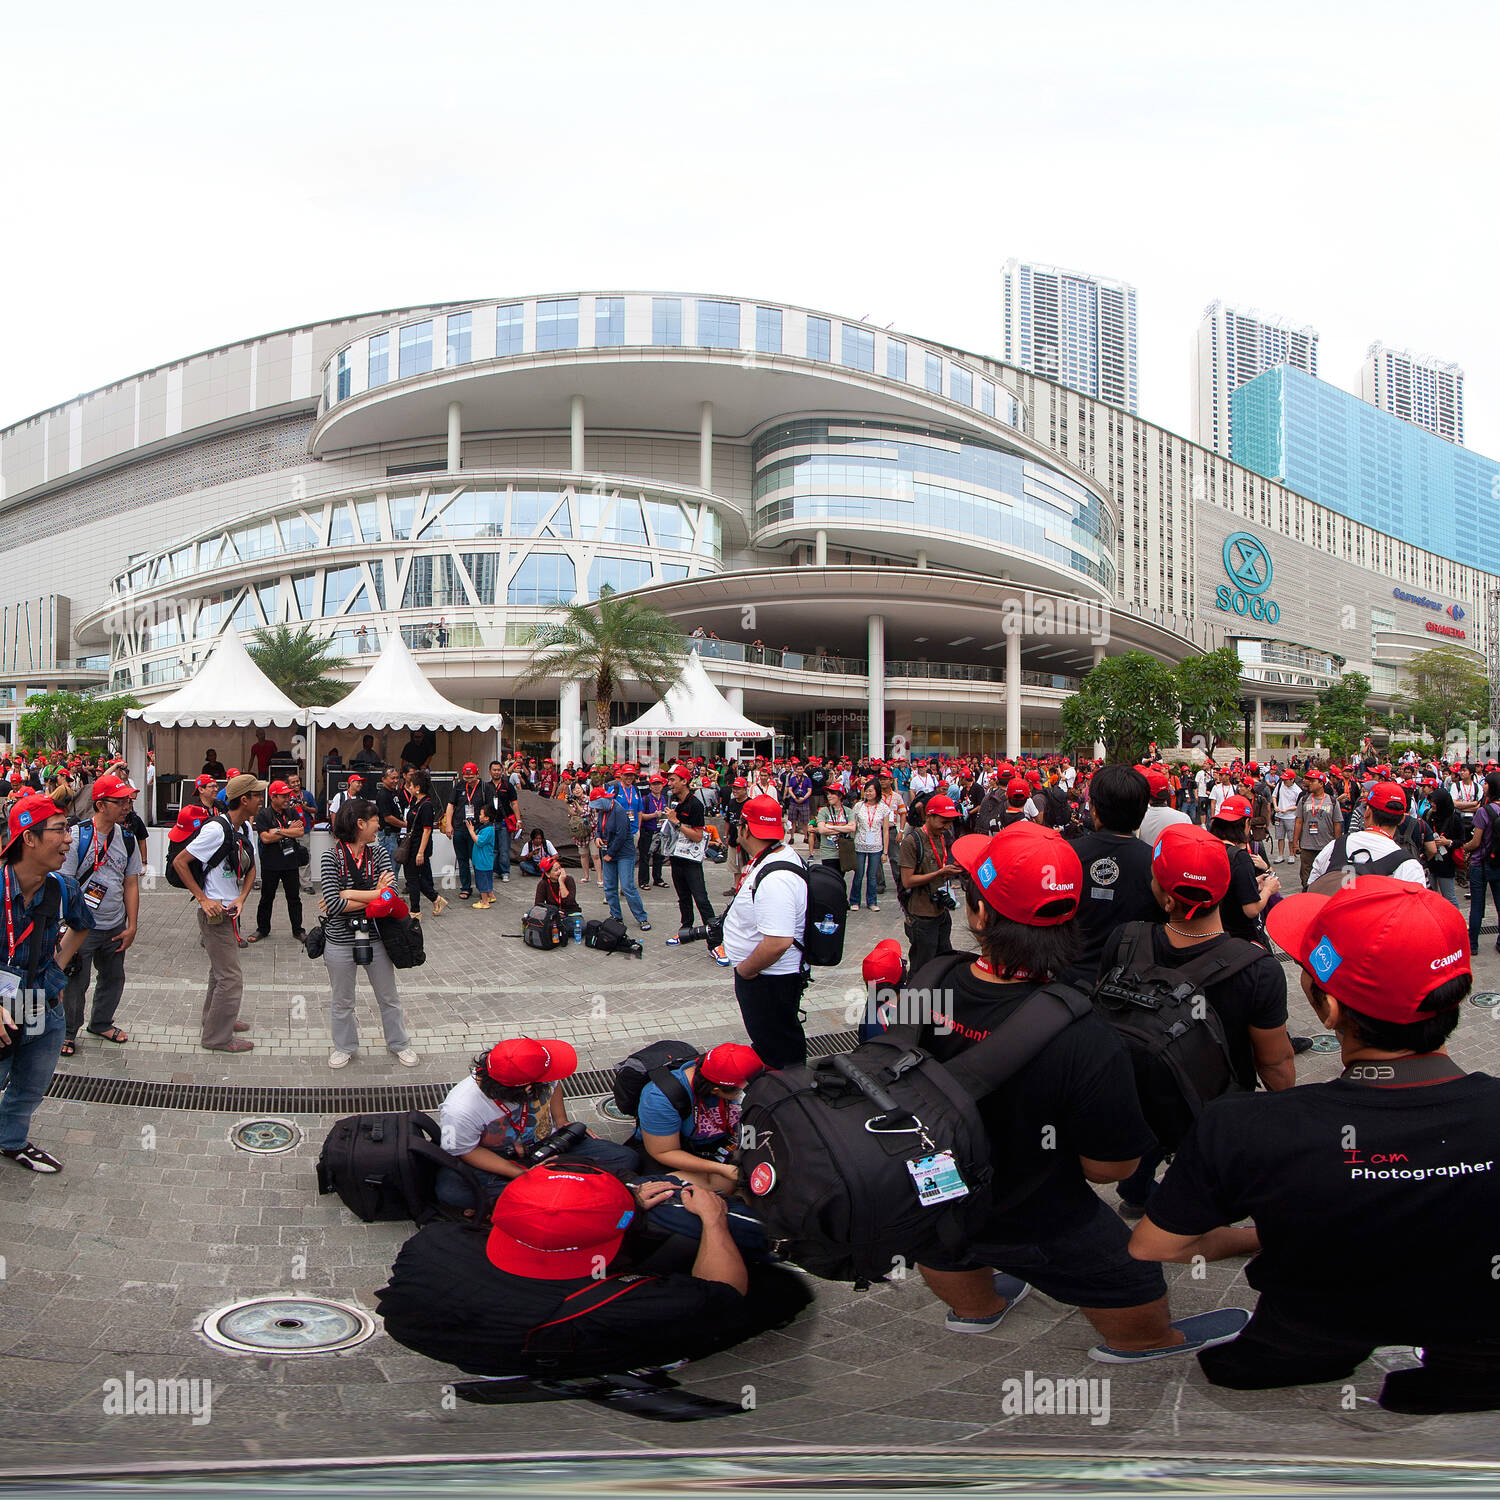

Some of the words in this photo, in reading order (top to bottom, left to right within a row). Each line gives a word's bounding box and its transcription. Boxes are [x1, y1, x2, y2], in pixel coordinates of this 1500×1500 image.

[1216, 584, 1281, 625] SOGO
[1393, 587, 1443, 612] Carrefour
[1425, 621, 1466, 640] GRAMEDIA
[1183, 872, 1207, 881] Canon
[1049, 882, 1074, 891] Canon
[1430, 948, 1463, 971] Canon
[1350, 1066, 1395, 1080] EOS
[1343, 1149, 1366, 1164] I
[1370, 1153, 1409, 1164] am
[1351, 1160, 1494, 1181] Photographer
